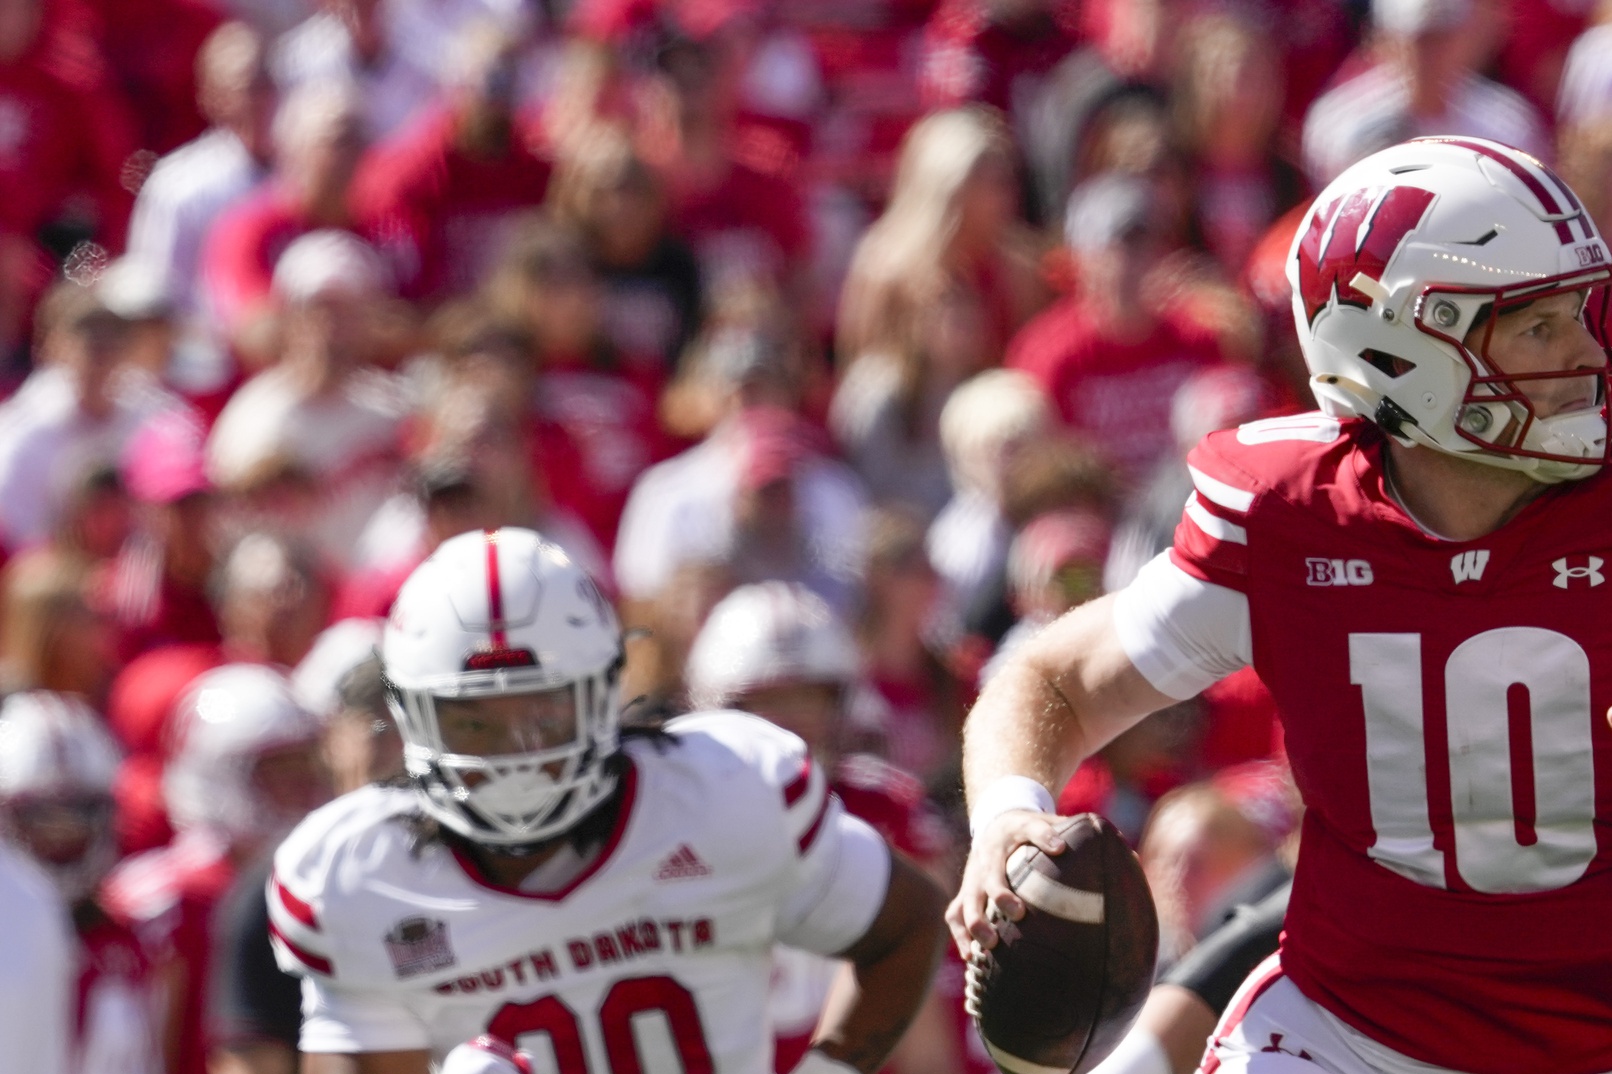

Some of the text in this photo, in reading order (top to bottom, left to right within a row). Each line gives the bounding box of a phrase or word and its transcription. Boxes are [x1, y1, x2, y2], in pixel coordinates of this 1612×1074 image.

[1450, 549, 1491, 585] W
[1348, 626, 1598, 895] 10
[567, 915, 714, 973] DAKOTA
